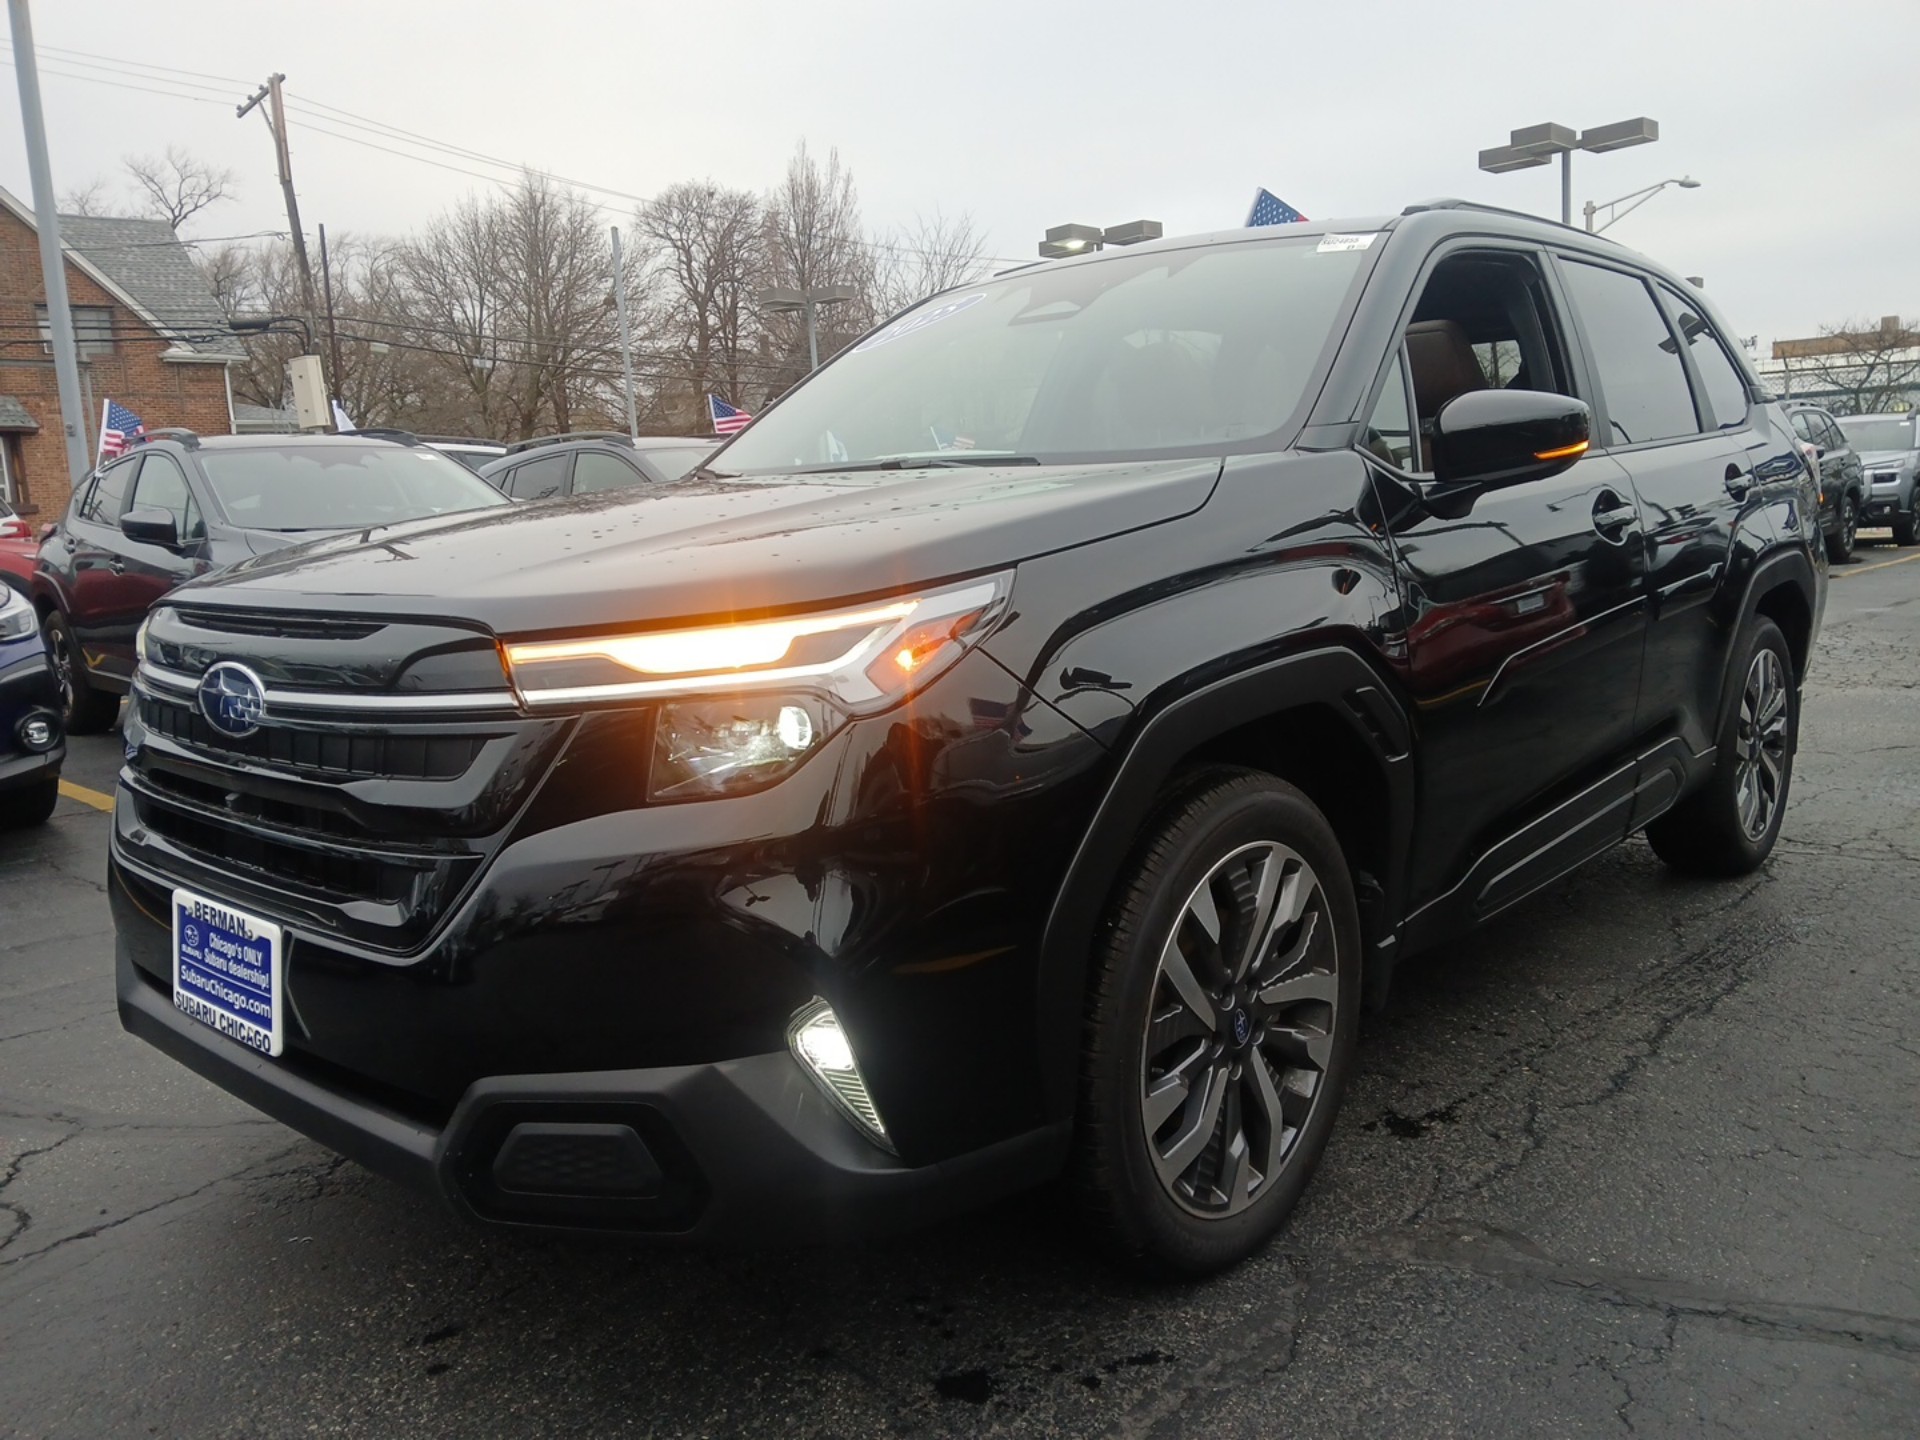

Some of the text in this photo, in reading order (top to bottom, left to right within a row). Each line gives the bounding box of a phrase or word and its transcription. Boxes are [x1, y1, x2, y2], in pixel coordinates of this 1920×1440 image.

[194, 901, 245, 938] BERMAN
[204, 947, 269, 989] Subaru dealership!
[209, 932, 263, 967] Chicago's ONLY
[181, 965, 271, 1018] SubaruChicago.com
[175, 991, 271, 1053] SUBARU CHICAGO
